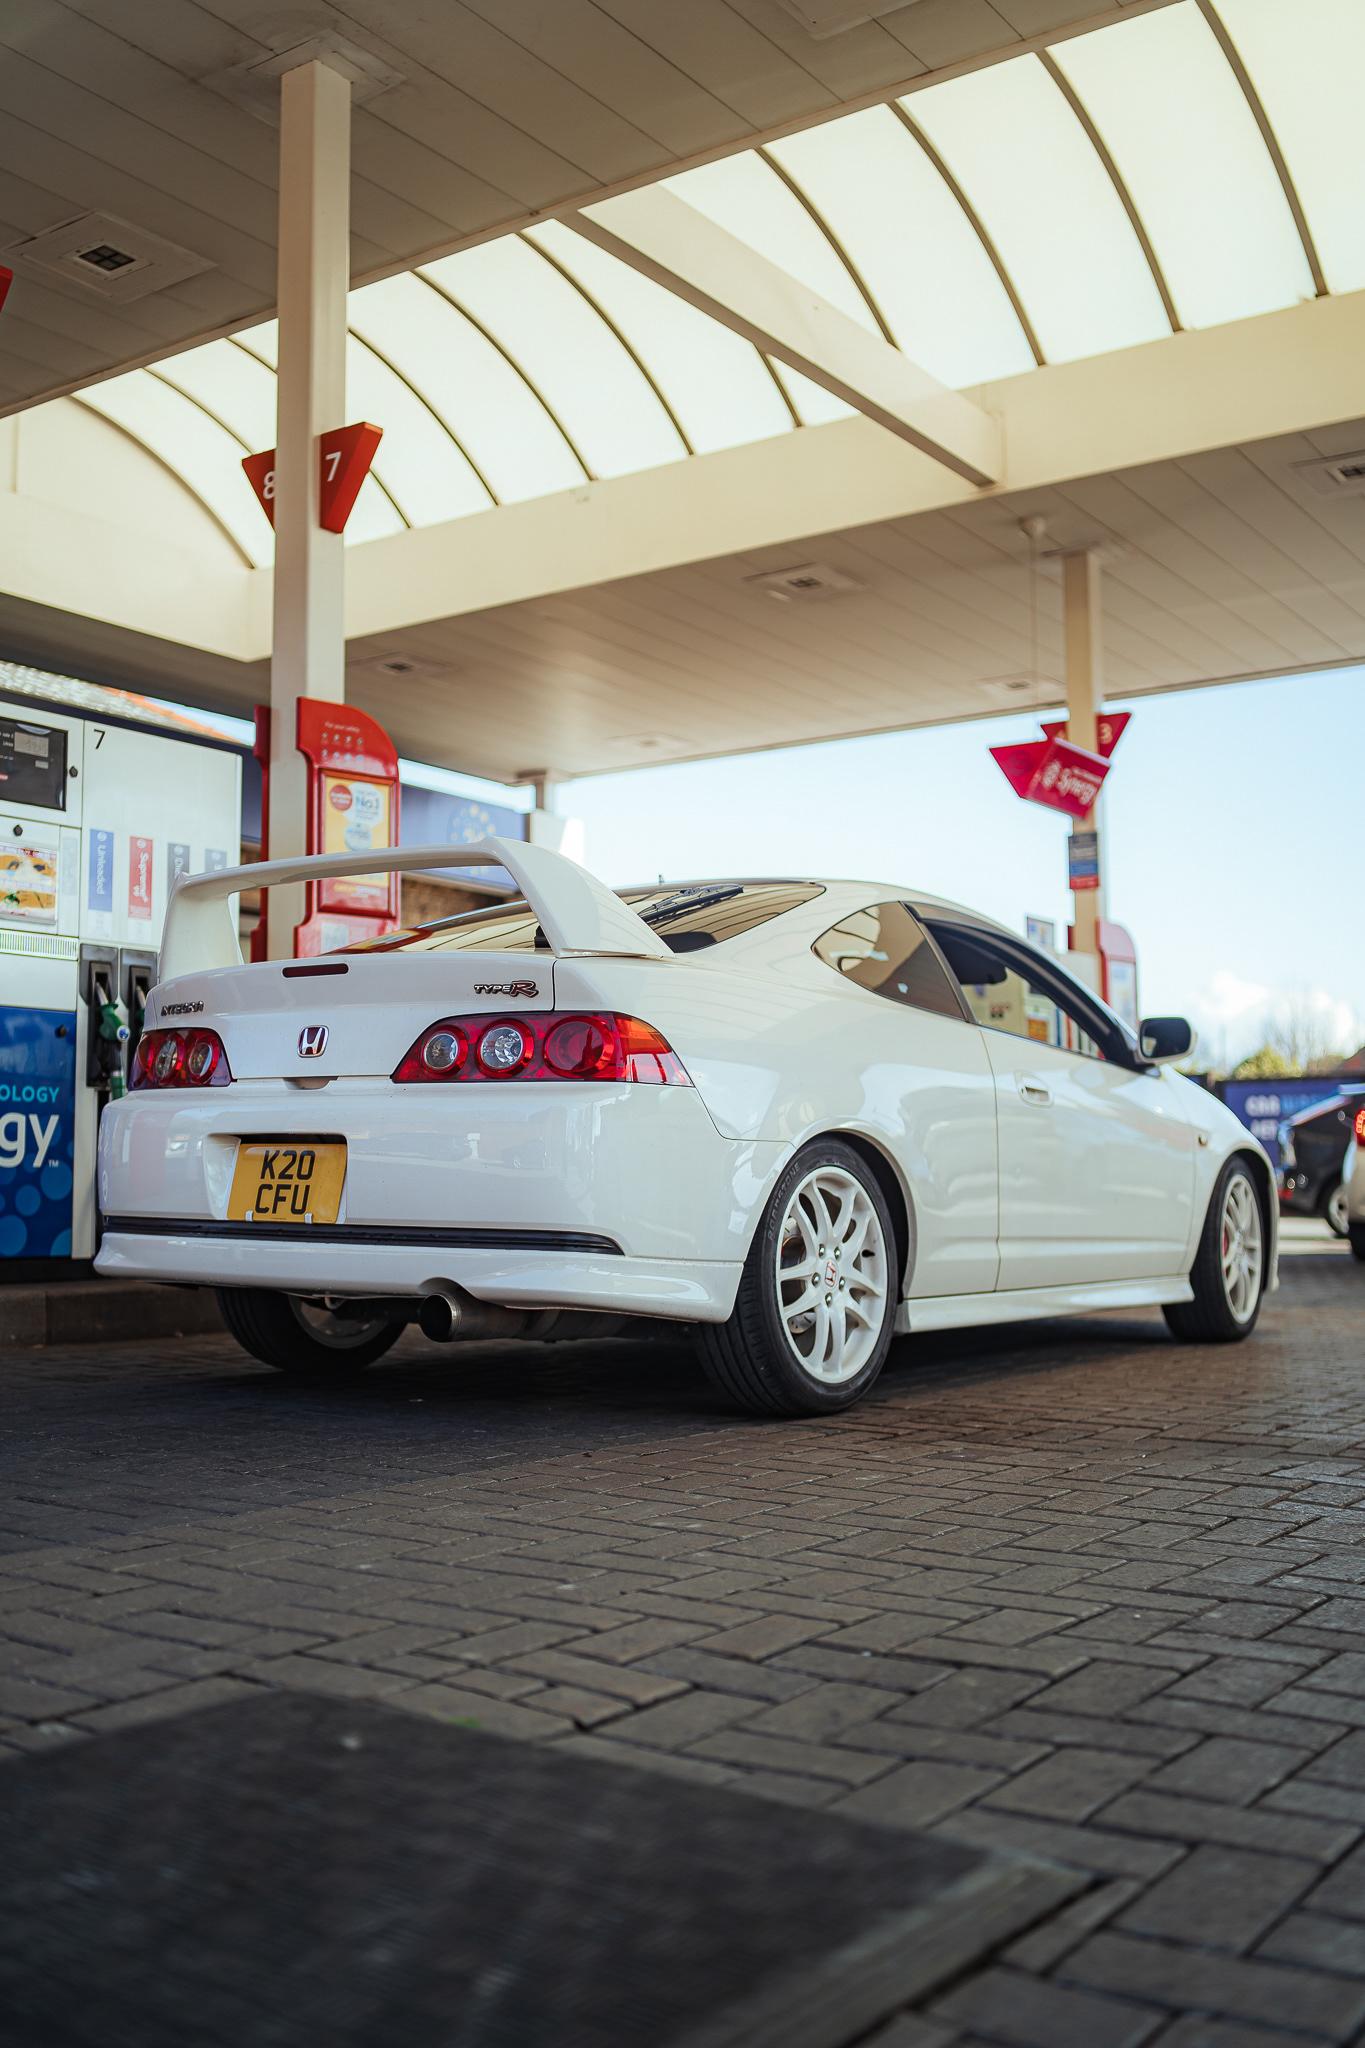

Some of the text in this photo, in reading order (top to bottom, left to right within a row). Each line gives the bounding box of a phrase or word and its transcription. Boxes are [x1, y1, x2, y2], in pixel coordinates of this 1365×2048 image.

[325, 451, 342, 482] 7
[93, 729, 106, 749] 7
[96, 844, 107, 895] Unleaded
[474, 980, 539, 998] TYPE R
[260, 1150, 316, 1180] K20
[255, 1184, 311, 1215] CFU
